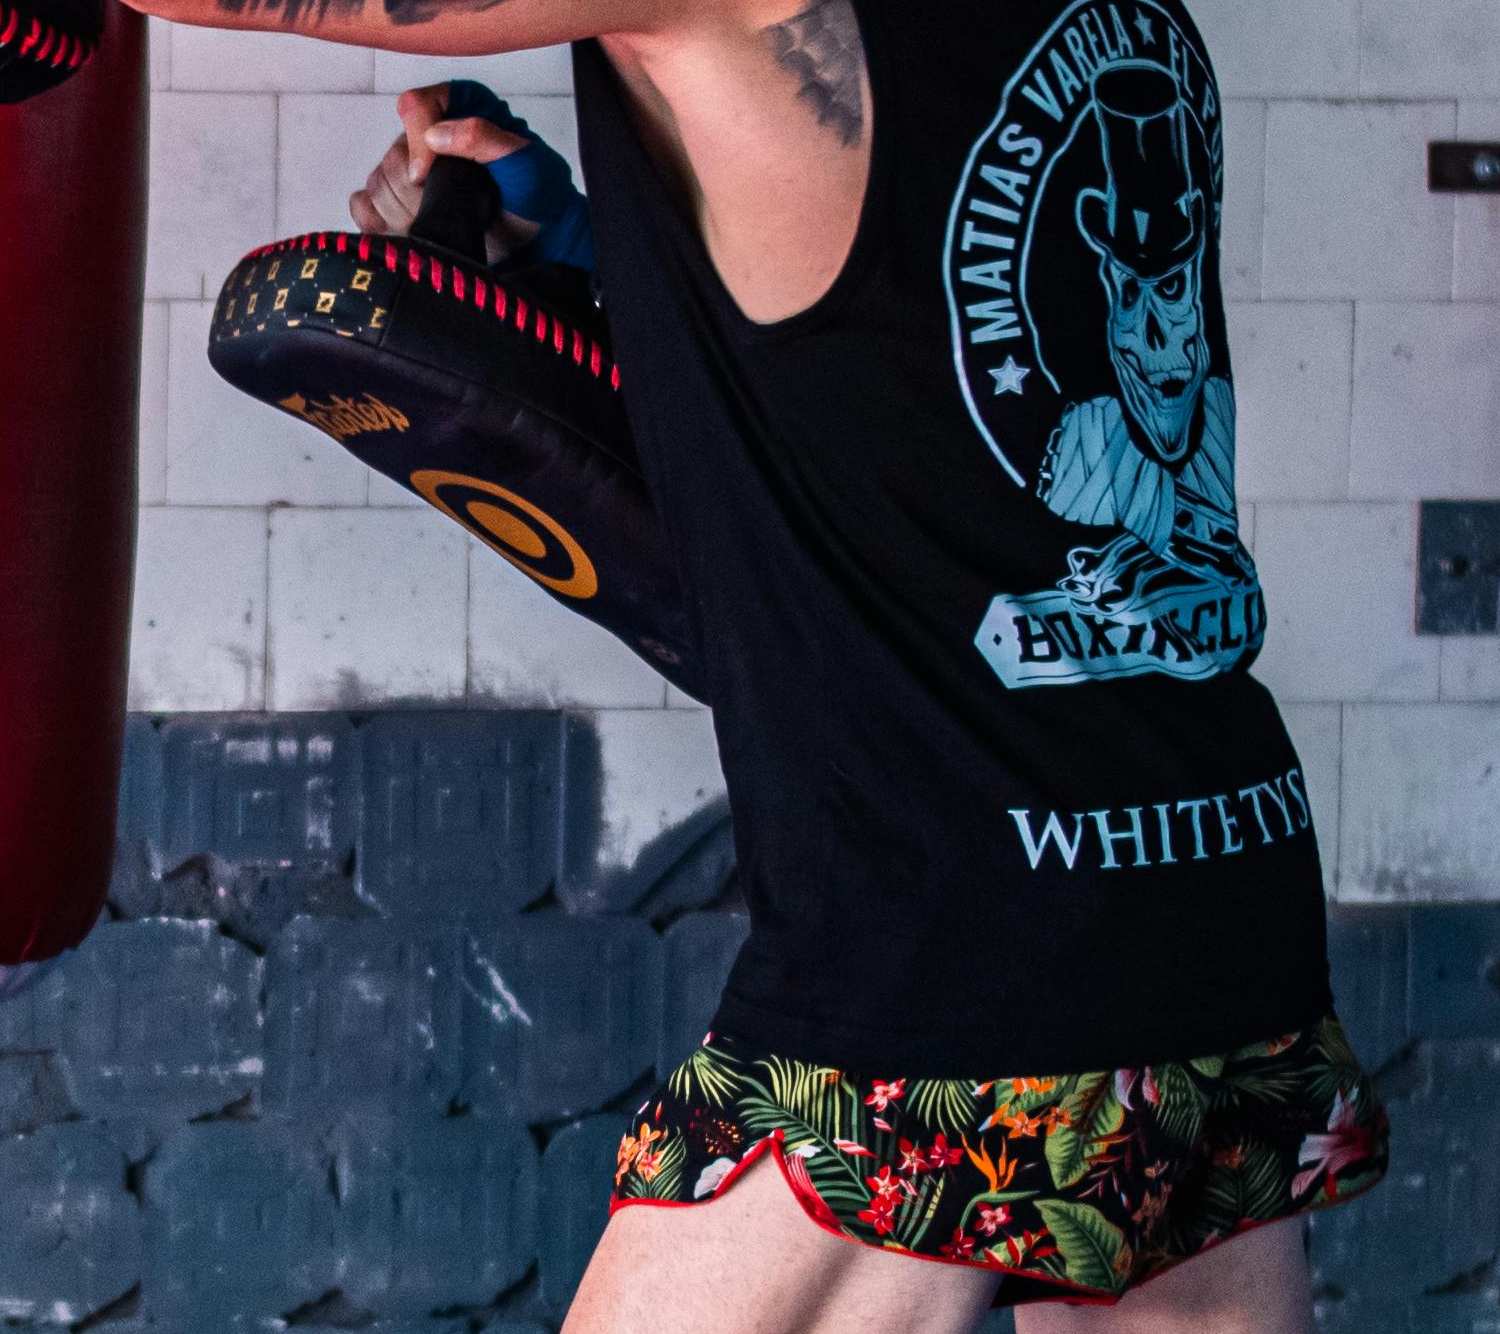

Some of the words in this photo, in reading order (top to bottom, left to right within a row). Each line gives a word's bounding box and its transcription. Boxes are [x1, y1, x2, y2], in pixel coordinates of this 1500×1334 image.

[960, 122, 1044, 345] MATIAS
[1022, 3, 1134, 123] VARELA
[1012, 607, 1203, 664] BOXIN
